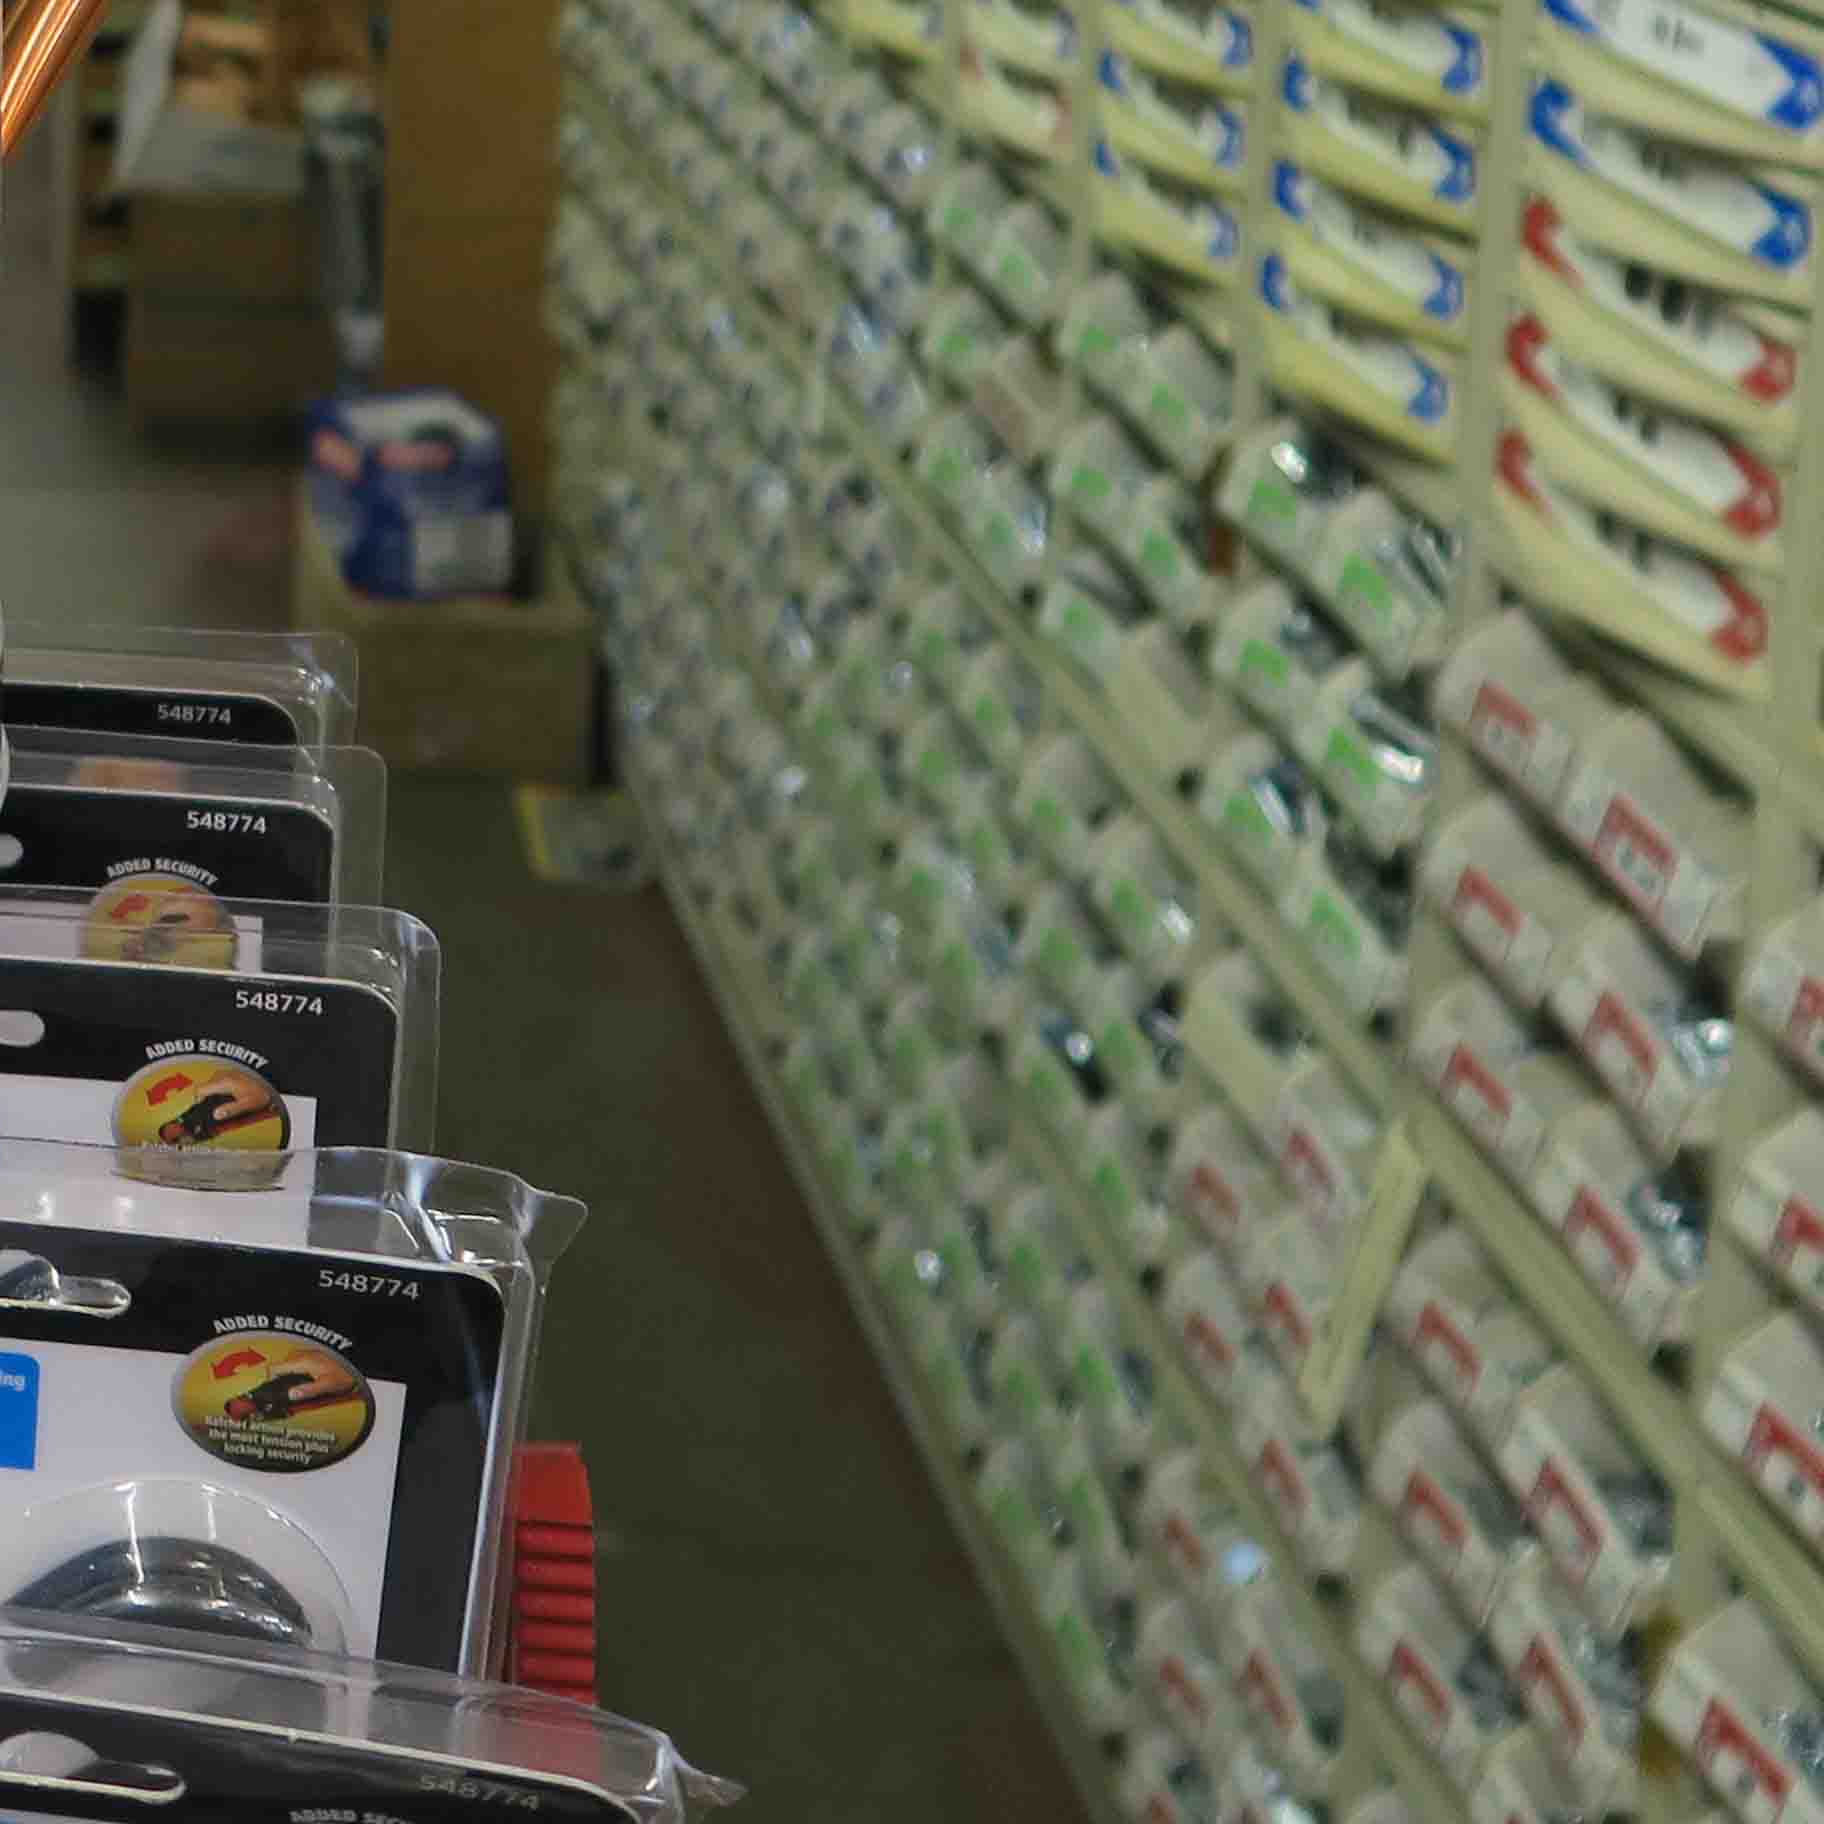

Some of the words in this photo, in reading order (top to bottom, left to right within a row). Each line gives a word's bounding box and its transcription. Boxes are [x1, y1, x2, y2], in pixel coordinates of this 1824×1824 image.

[157, 702, 232, 725] 548774
[185, 809, 267, 834] 548774
[107, 857, 151, 879] ADDED
[154, 857, 219, 888] SECURITY
[234, 990, 324, 1016] 548774
[144, 1038, 195, 1060] ADDED
[198, 1038, 270, 1069] SECURITY
[318, 1269, 420, 1301] 548774
[212, 1314, 270, 1335] ADDED
[273, 1314, 353, 1351] SECURITY
[420, 1774, 541, 1812] 548774
